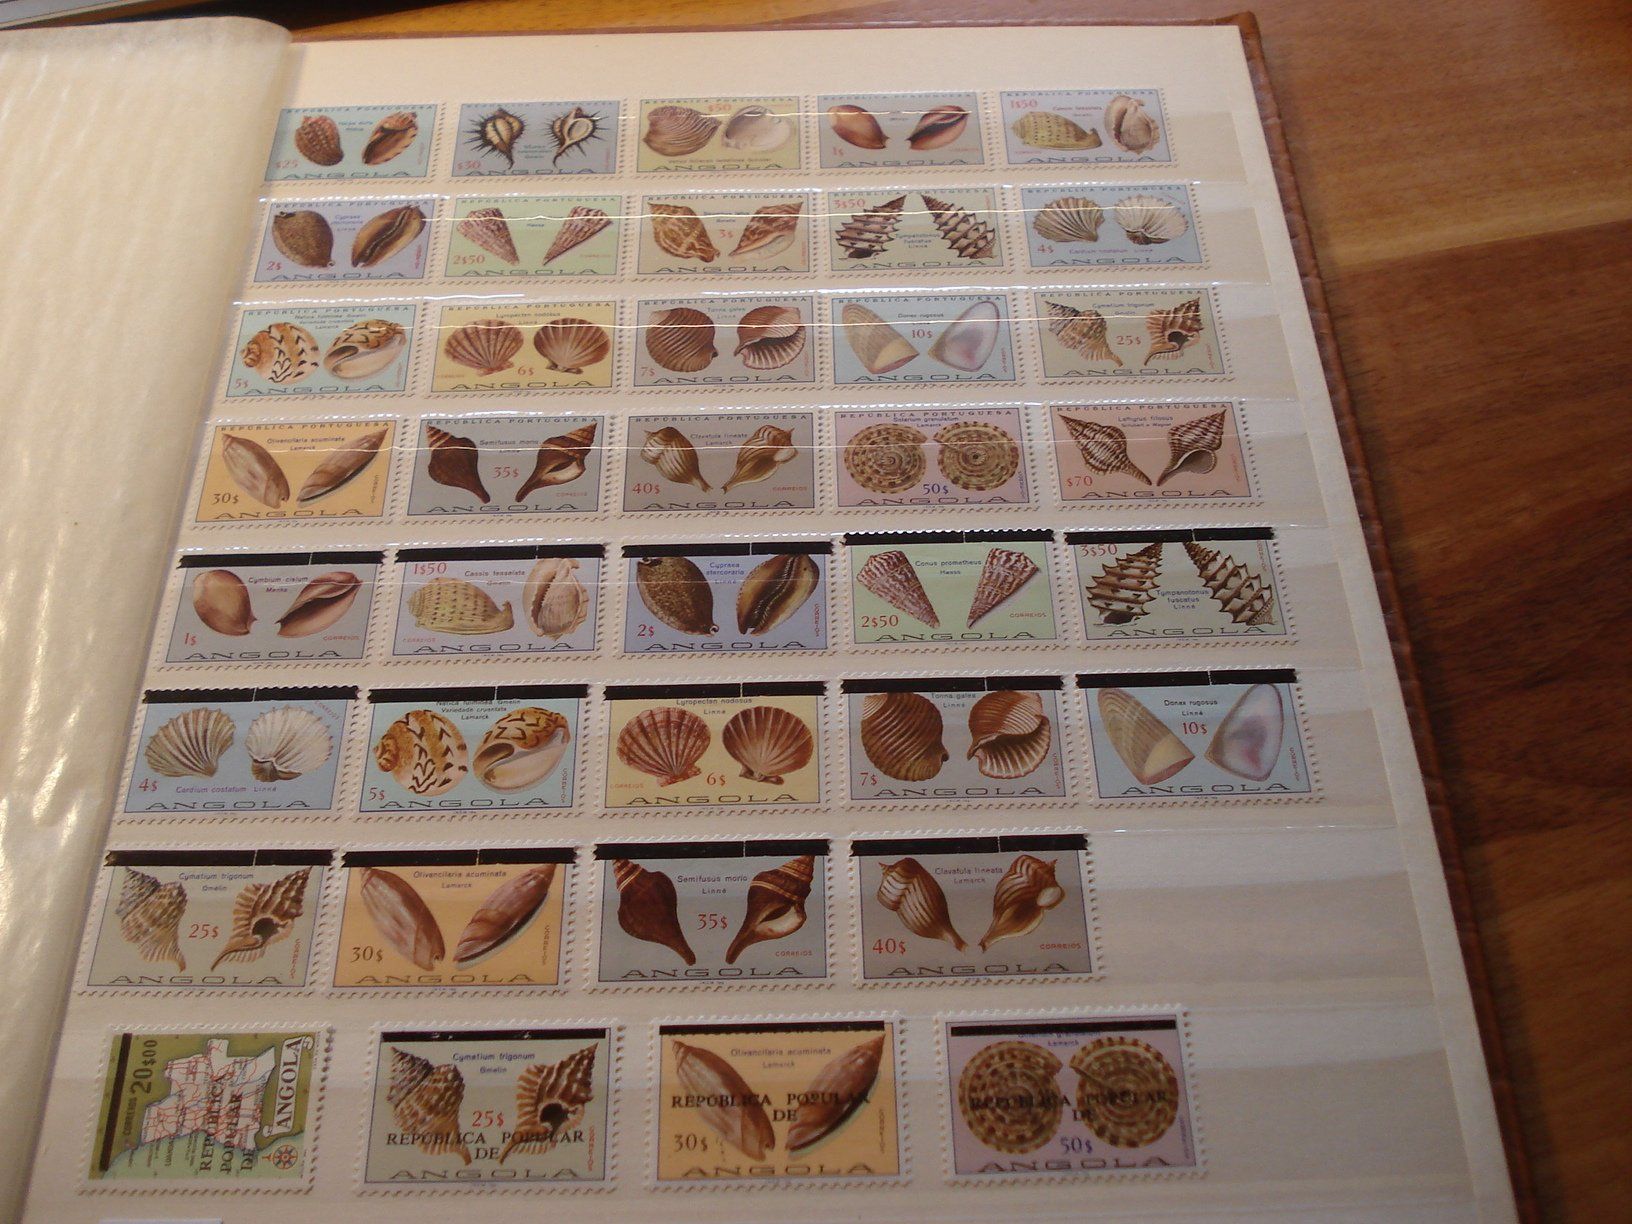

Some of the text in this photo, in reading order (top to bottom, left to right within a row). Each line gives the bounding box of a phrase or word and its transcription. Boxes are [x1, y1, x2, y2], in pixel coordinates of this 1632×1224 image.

[840, 159, 966, 167] ANGOLA
[1027, 155, 1155, 163] ANGOLA
[653, 162, 783, 170] ANGOLA
[850, 259, 986, 268] ANGOLA
[1050, 256, 1185, 265] ANGOLA
[462, 268, 598, 277] ANGOLA
[656, 265, 791, 273] ANGOLA
[272, 272, 404, 280] ANGOLA
[911, 328, 933, 339] 10$
[1116, 336, 1141, 346] 25$
[517, 364, 534, 376] 6$
[1064, 367, 1207, 376] ANGOLA
[654, 375, 798, 384] ANGOLA
[853, 373, 997, 382] ANGOLA
[244, 384, 386, 395] ANGOLA
[451, 380, 595, 390] ANGOLA
[492, 467, 520, 479] 35$
[1066, 475, 1093, 488] $70
[632, 483, 662, 495] 40$
[922, 484, 949, 496] 50$
[1081, 489, 1234, 499] ANGOLA
[212, 492, 240, 505] 30$
[857, 496, 1012, 506] ANGOLA
[427, 503, 579, 513] ANGOLA
[643, 501, 797, 510] ANGOLA
[213, 508, 364, 519] ANGOLA
[1079, 544, 1117, 557] 3$50
[414, 562, 447, 575] 1$50
[861, 614, 899, 628] 2$50
[637, 624, 655, 638] 2$
[876, 630, 1035, 642] ANGOLA
[1109, 625, 1266, 637] ANGOLA
[184, 633, 196, 646] 1$
[414, 643, 574, 654] ANGOLA
[645, 641, 807, 652] ANGOLA
[185, 650, 342, 660] ANGOLA
[1181, 721, 1208, 735] 10$
[707, 770, 727, 786] 6$
[860, 771, 879, 785] 7$
[138, 777, 158, 792] 4$
[1121, 783, 1291, 795] ANGOLA
[368, 786, 385, 801] 5$
[873, 786, 1046, 798] ANGOLA
[145, 800, 311, 811] ANGOLA
[380, 797, 550, 809] ANGOLA
[626, 793, 800, 806] ANGOLA
[697, 914, 728, 931] 35$
[188, 923, 220, 939] 25$
[871, 937, 907, 954] 40$
[1039, 942, 1082, 950] CORREIOS
[350, 945, 383, 962] 30$
[622, 965, 806, 979] ANGOLA
[887, 963, 1071, 976] ANGOLA
[109, 974, 283, 985] ANGOLA
[355, 973, 537, 985] ANGOLA
[130, 1037, 159, 1094] 20$00
[275, 1037, 304, 1130] ANGOLA
[472, 1110, 504, 1128] 25$
[773, 1109, 798, 1122] DE
[673, 1133, 708, 1150] 30$
[1060, 1136, 1093, 1154] 50$
[475, 1147, 501, 1161] DE
[682, 1163, 873, 1176] ANGOLA
[980, 1157, 1176, 1172] ANGOLA
[390, 1167, 579, 1179] ANGOLA
